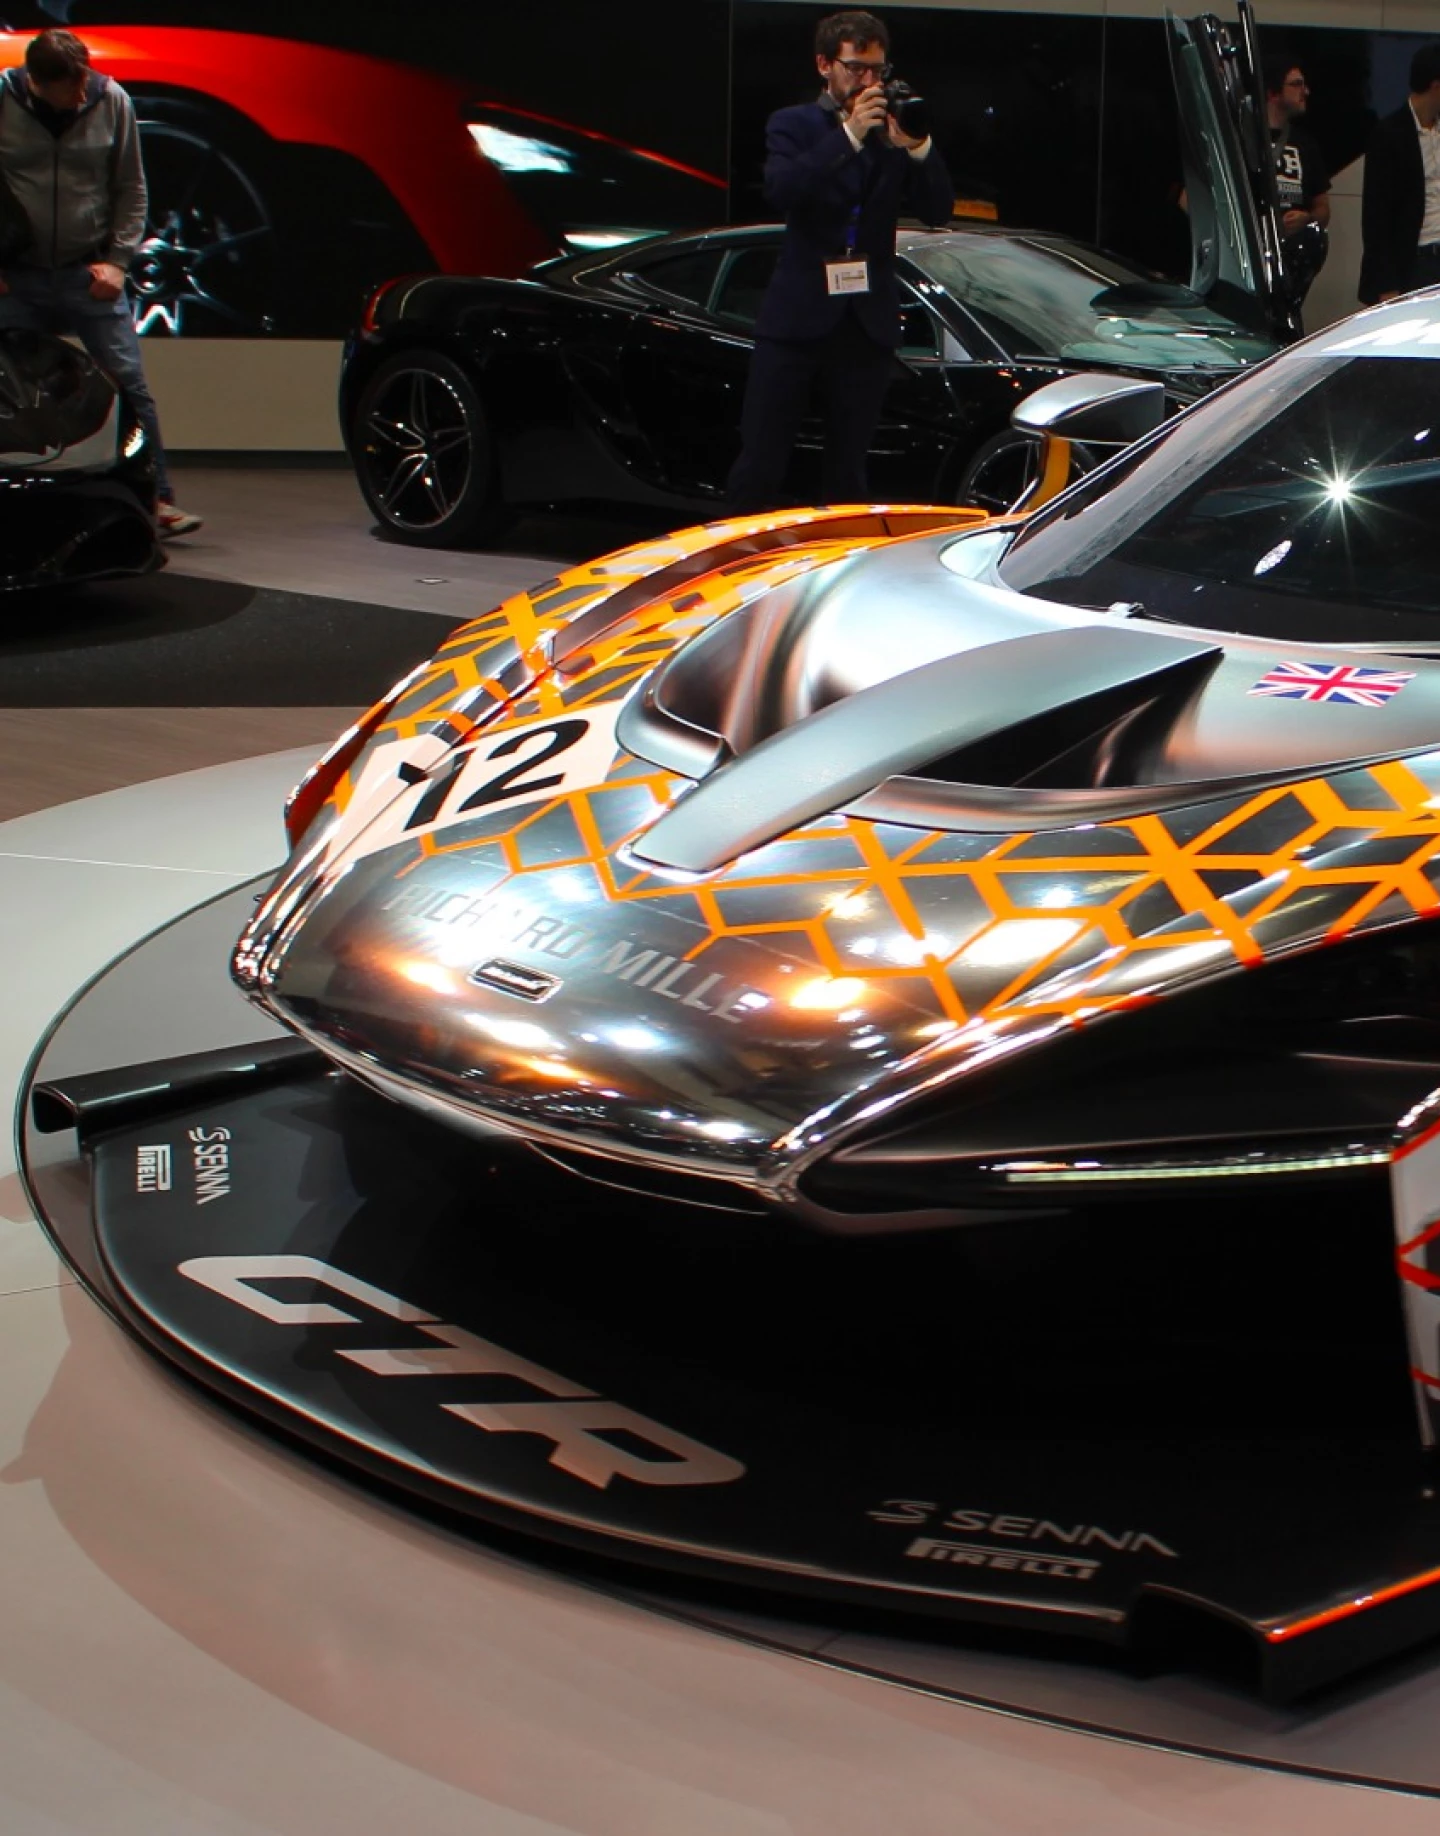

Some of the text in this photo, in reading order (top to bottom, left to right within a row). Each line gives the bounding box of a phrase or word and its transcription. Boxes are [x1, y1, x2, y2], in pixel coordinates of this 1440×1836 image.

[398, 718, 590, 833] 12
[384, 882, 756, 1024] RICHRD MILLE
[137, 1144, 171, 1192] PIRELLI
[194, 1143, 231, 1205] SENNA
[177, 1254, 746, 1489] GTR
[905, 1536, 1102, 1580] PIRELLI
[943, 1509, 1180, 1558] SENNA
